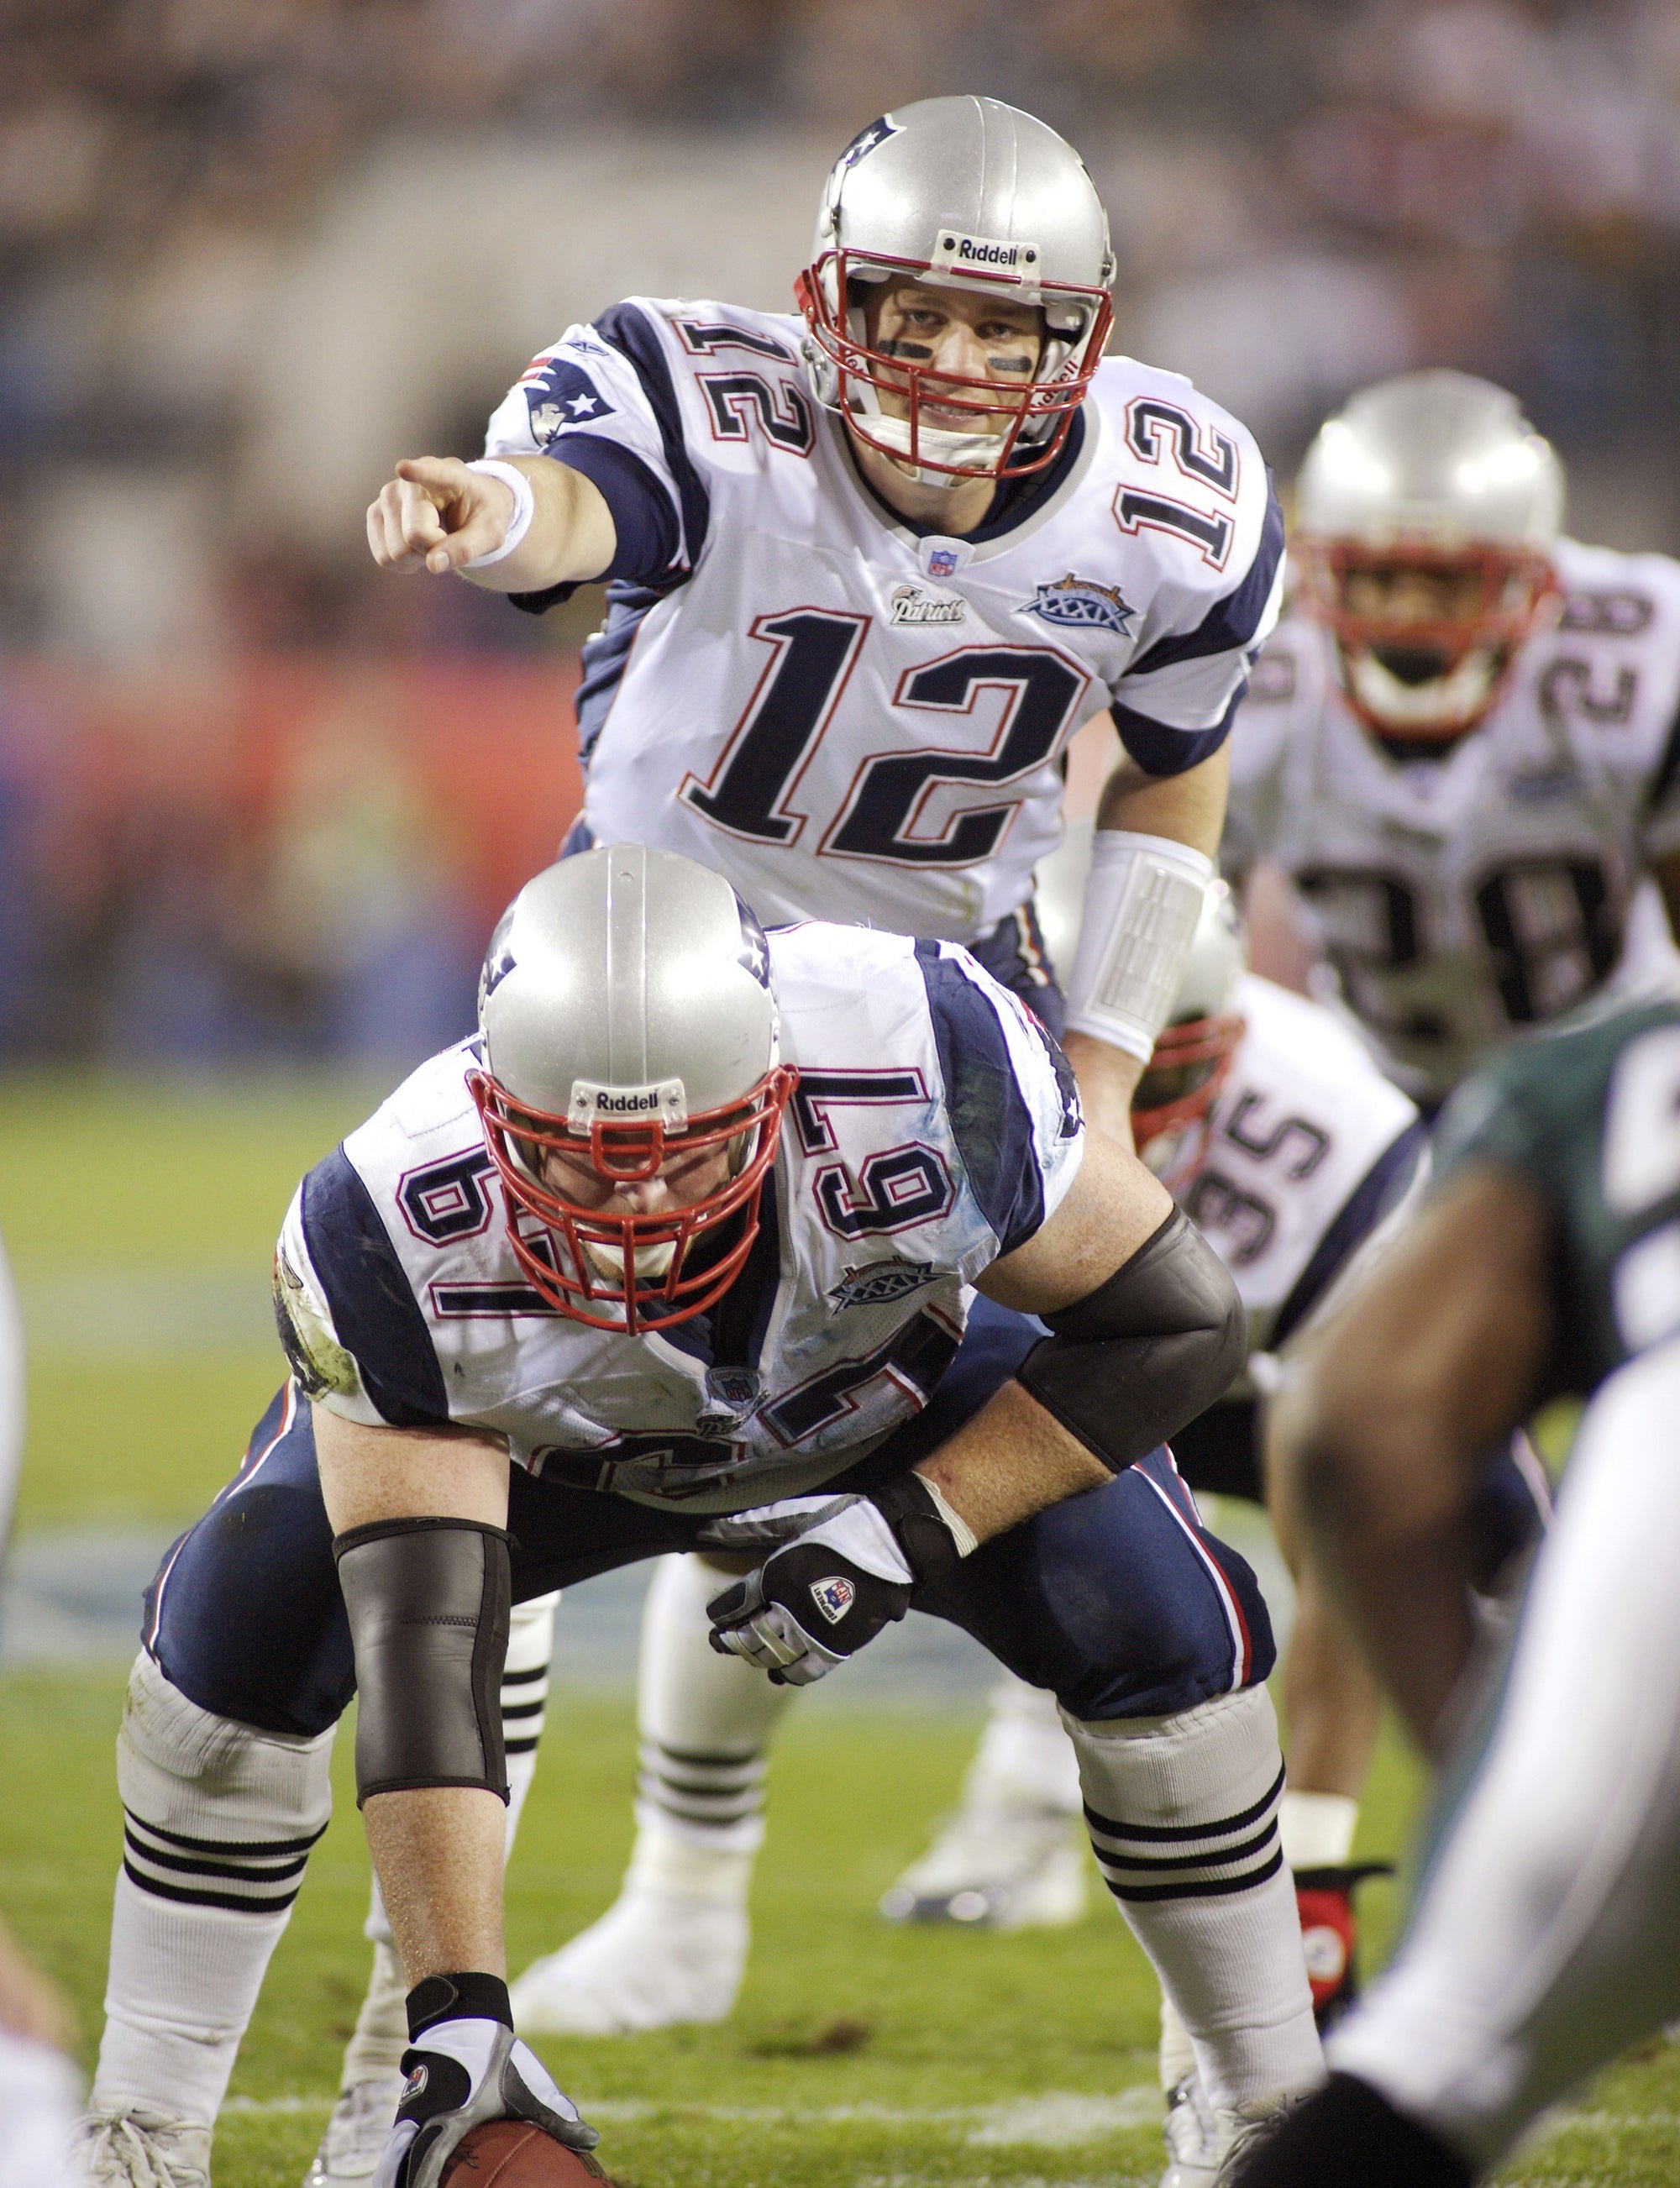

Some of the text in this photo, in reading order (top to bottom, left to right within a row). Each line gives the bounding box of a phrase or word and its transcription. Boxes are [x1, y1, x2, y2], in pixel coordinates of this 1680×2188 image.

[958, 239, 1018, 266] Riddell
[674, 319, 818, 459] 12
[1111, 396, 1242, 574] 12
[1017, 586, 1137, 638] XXXIX
[1536, 590, 1655, 768] 28
[676, 605, 1092, 870] 12
[596, 1092, 659, 1111] Riddell
[789, 1065, 957, 1243] 67
[395, 1141, 573, 1320] 67
[1184, 1089, 1331, 1268] 35
[831, 1265, 954, 1318] XXXIX
[727, 1387, 753, 1402] NFL
[833, 1581, 852, 1605] NFL
